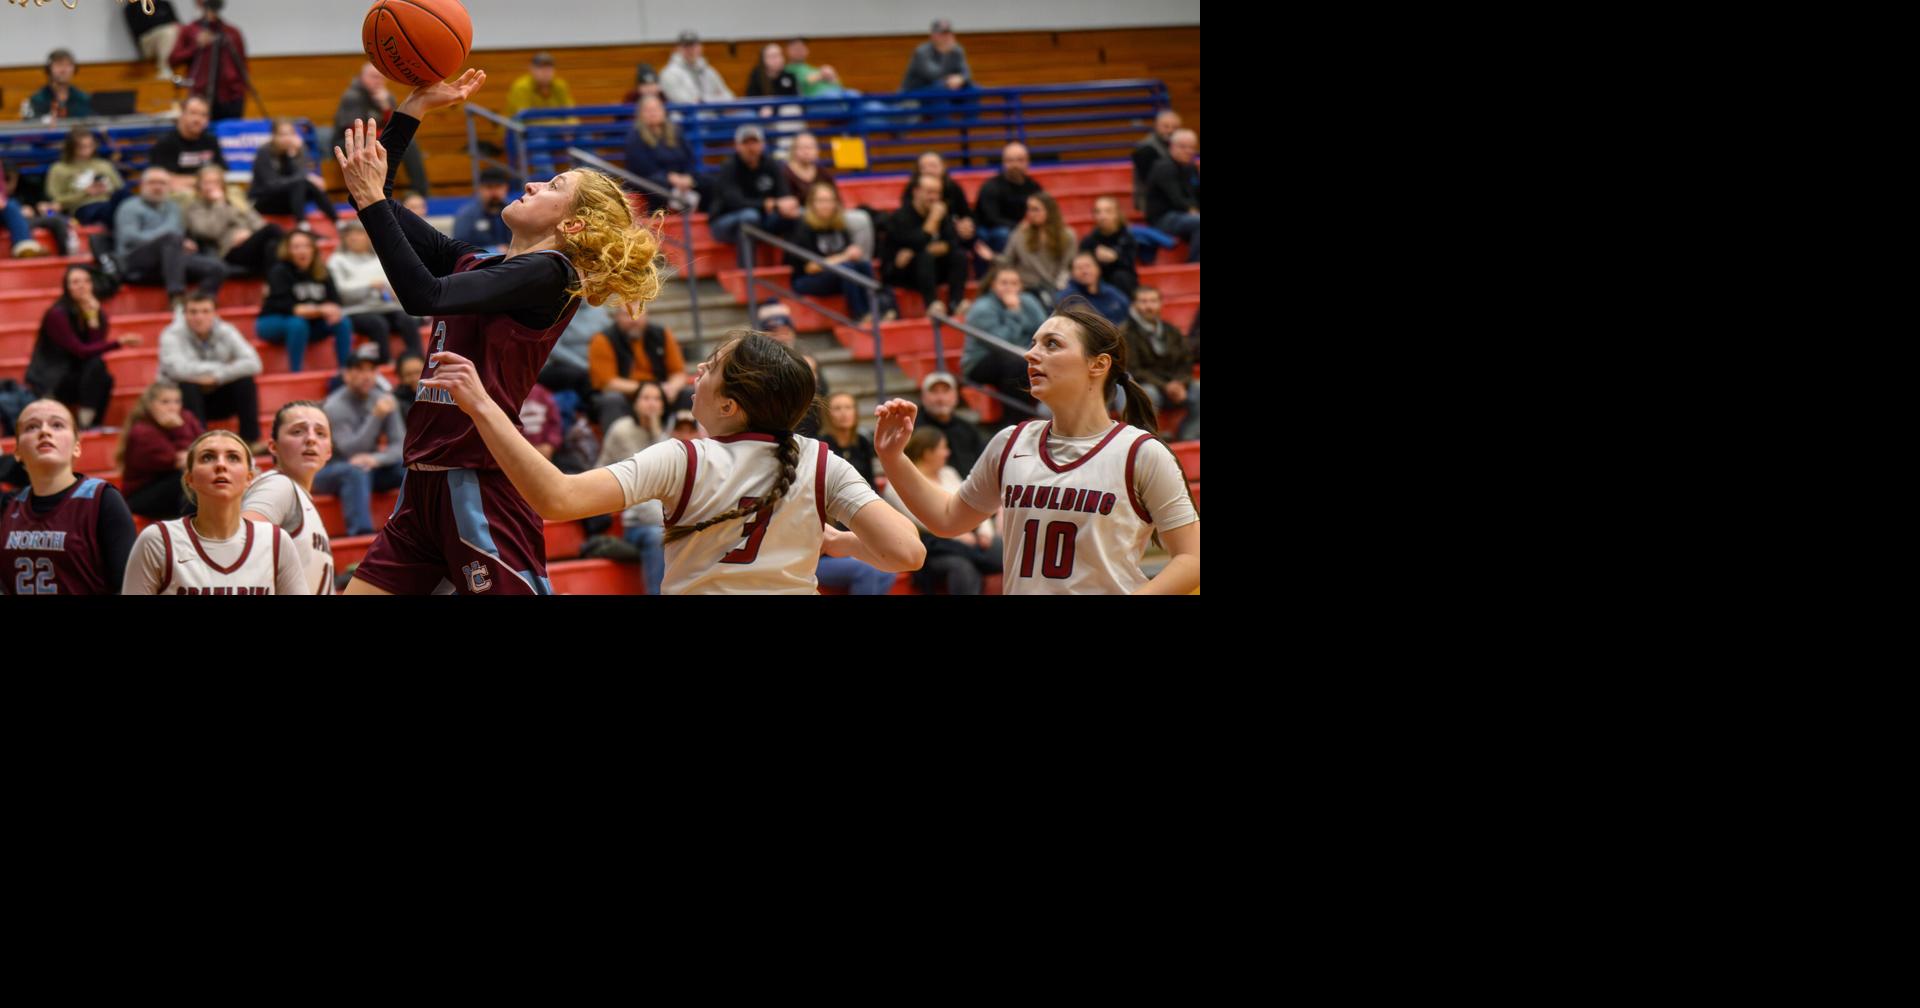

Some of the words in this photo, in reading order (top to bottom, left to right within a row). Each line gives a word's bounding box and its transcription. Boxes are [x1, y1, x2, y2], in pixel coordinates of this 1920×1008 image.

[1005, 485, 1117, 515] SPAULDING
[5, 531, 67, 551] NORTH
[718, 497, 780, 564] 3
[1020, 518, 1078, 579] 10
[15, 556, 58, 595] 22
